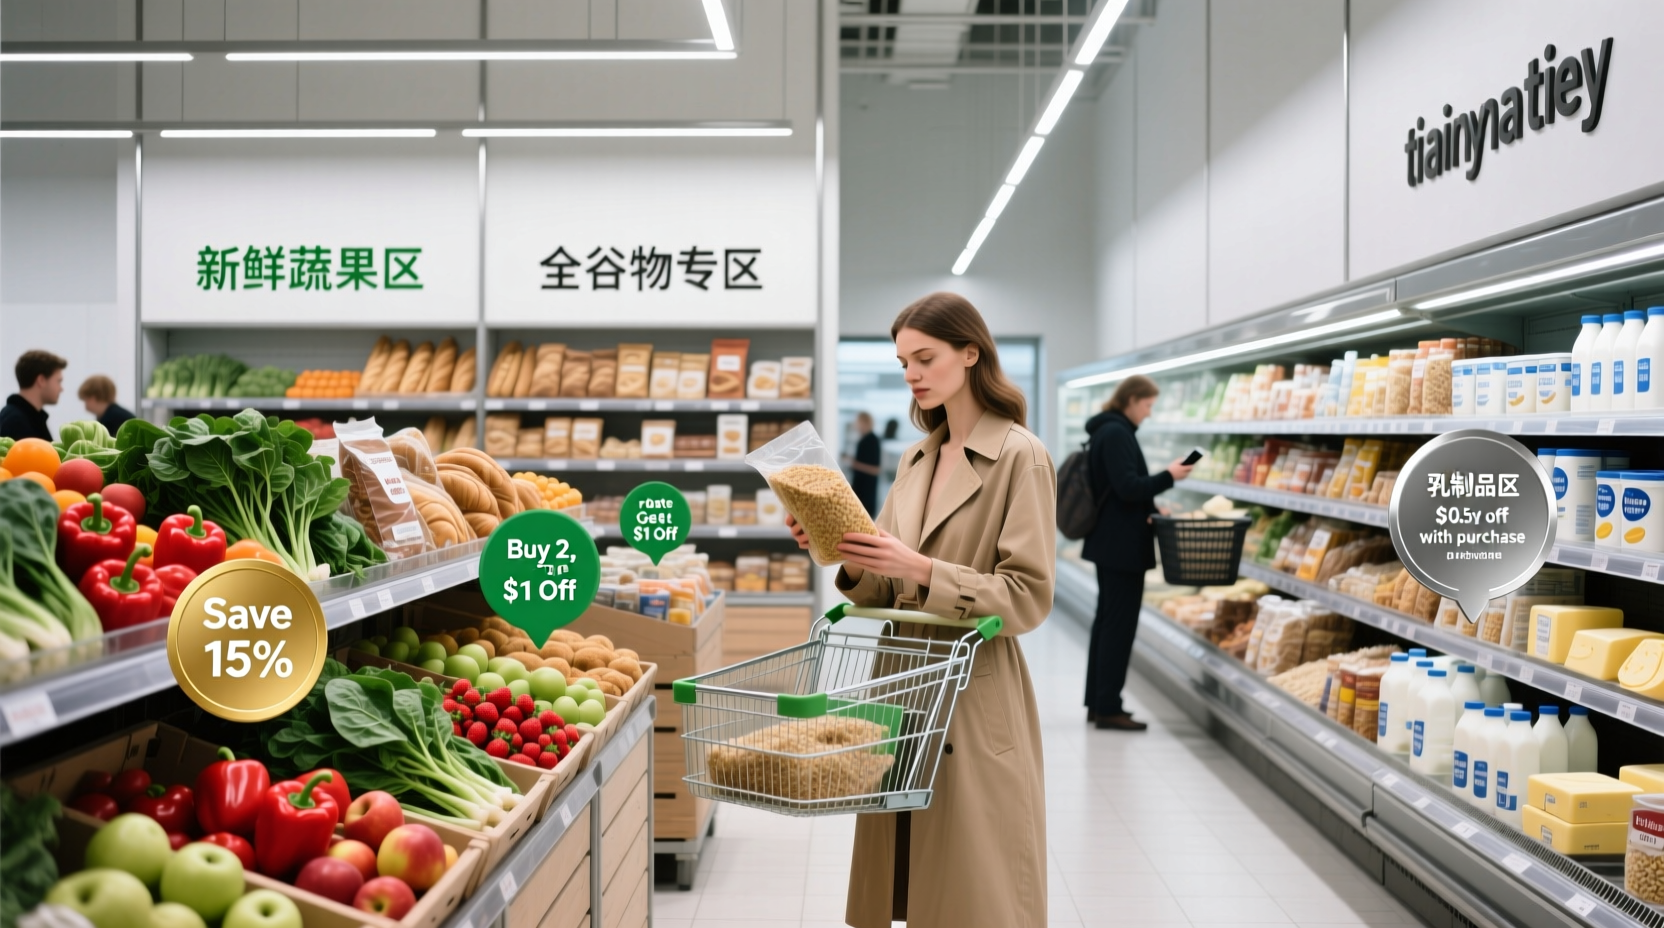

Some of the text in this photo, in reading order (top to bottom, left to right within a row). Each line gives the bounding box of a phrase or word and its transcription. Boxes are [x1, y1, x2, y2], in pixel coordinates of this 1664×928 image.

[196, 245, 424, 291] 新鲜蔬果区
[540, 245, 763, 291] 全谷物专区
[1485, 506, 1510, 524] off
[633, 526, 679, 542] $1 Off
[1419, 529, 1526, 547] with purchase
[507, 538, 577, 564] Buy 2,
[503, 576, 577, 604] $1 Off
[203, 597, 293, 630] Save
[204, 640, 294, 678] 15%
